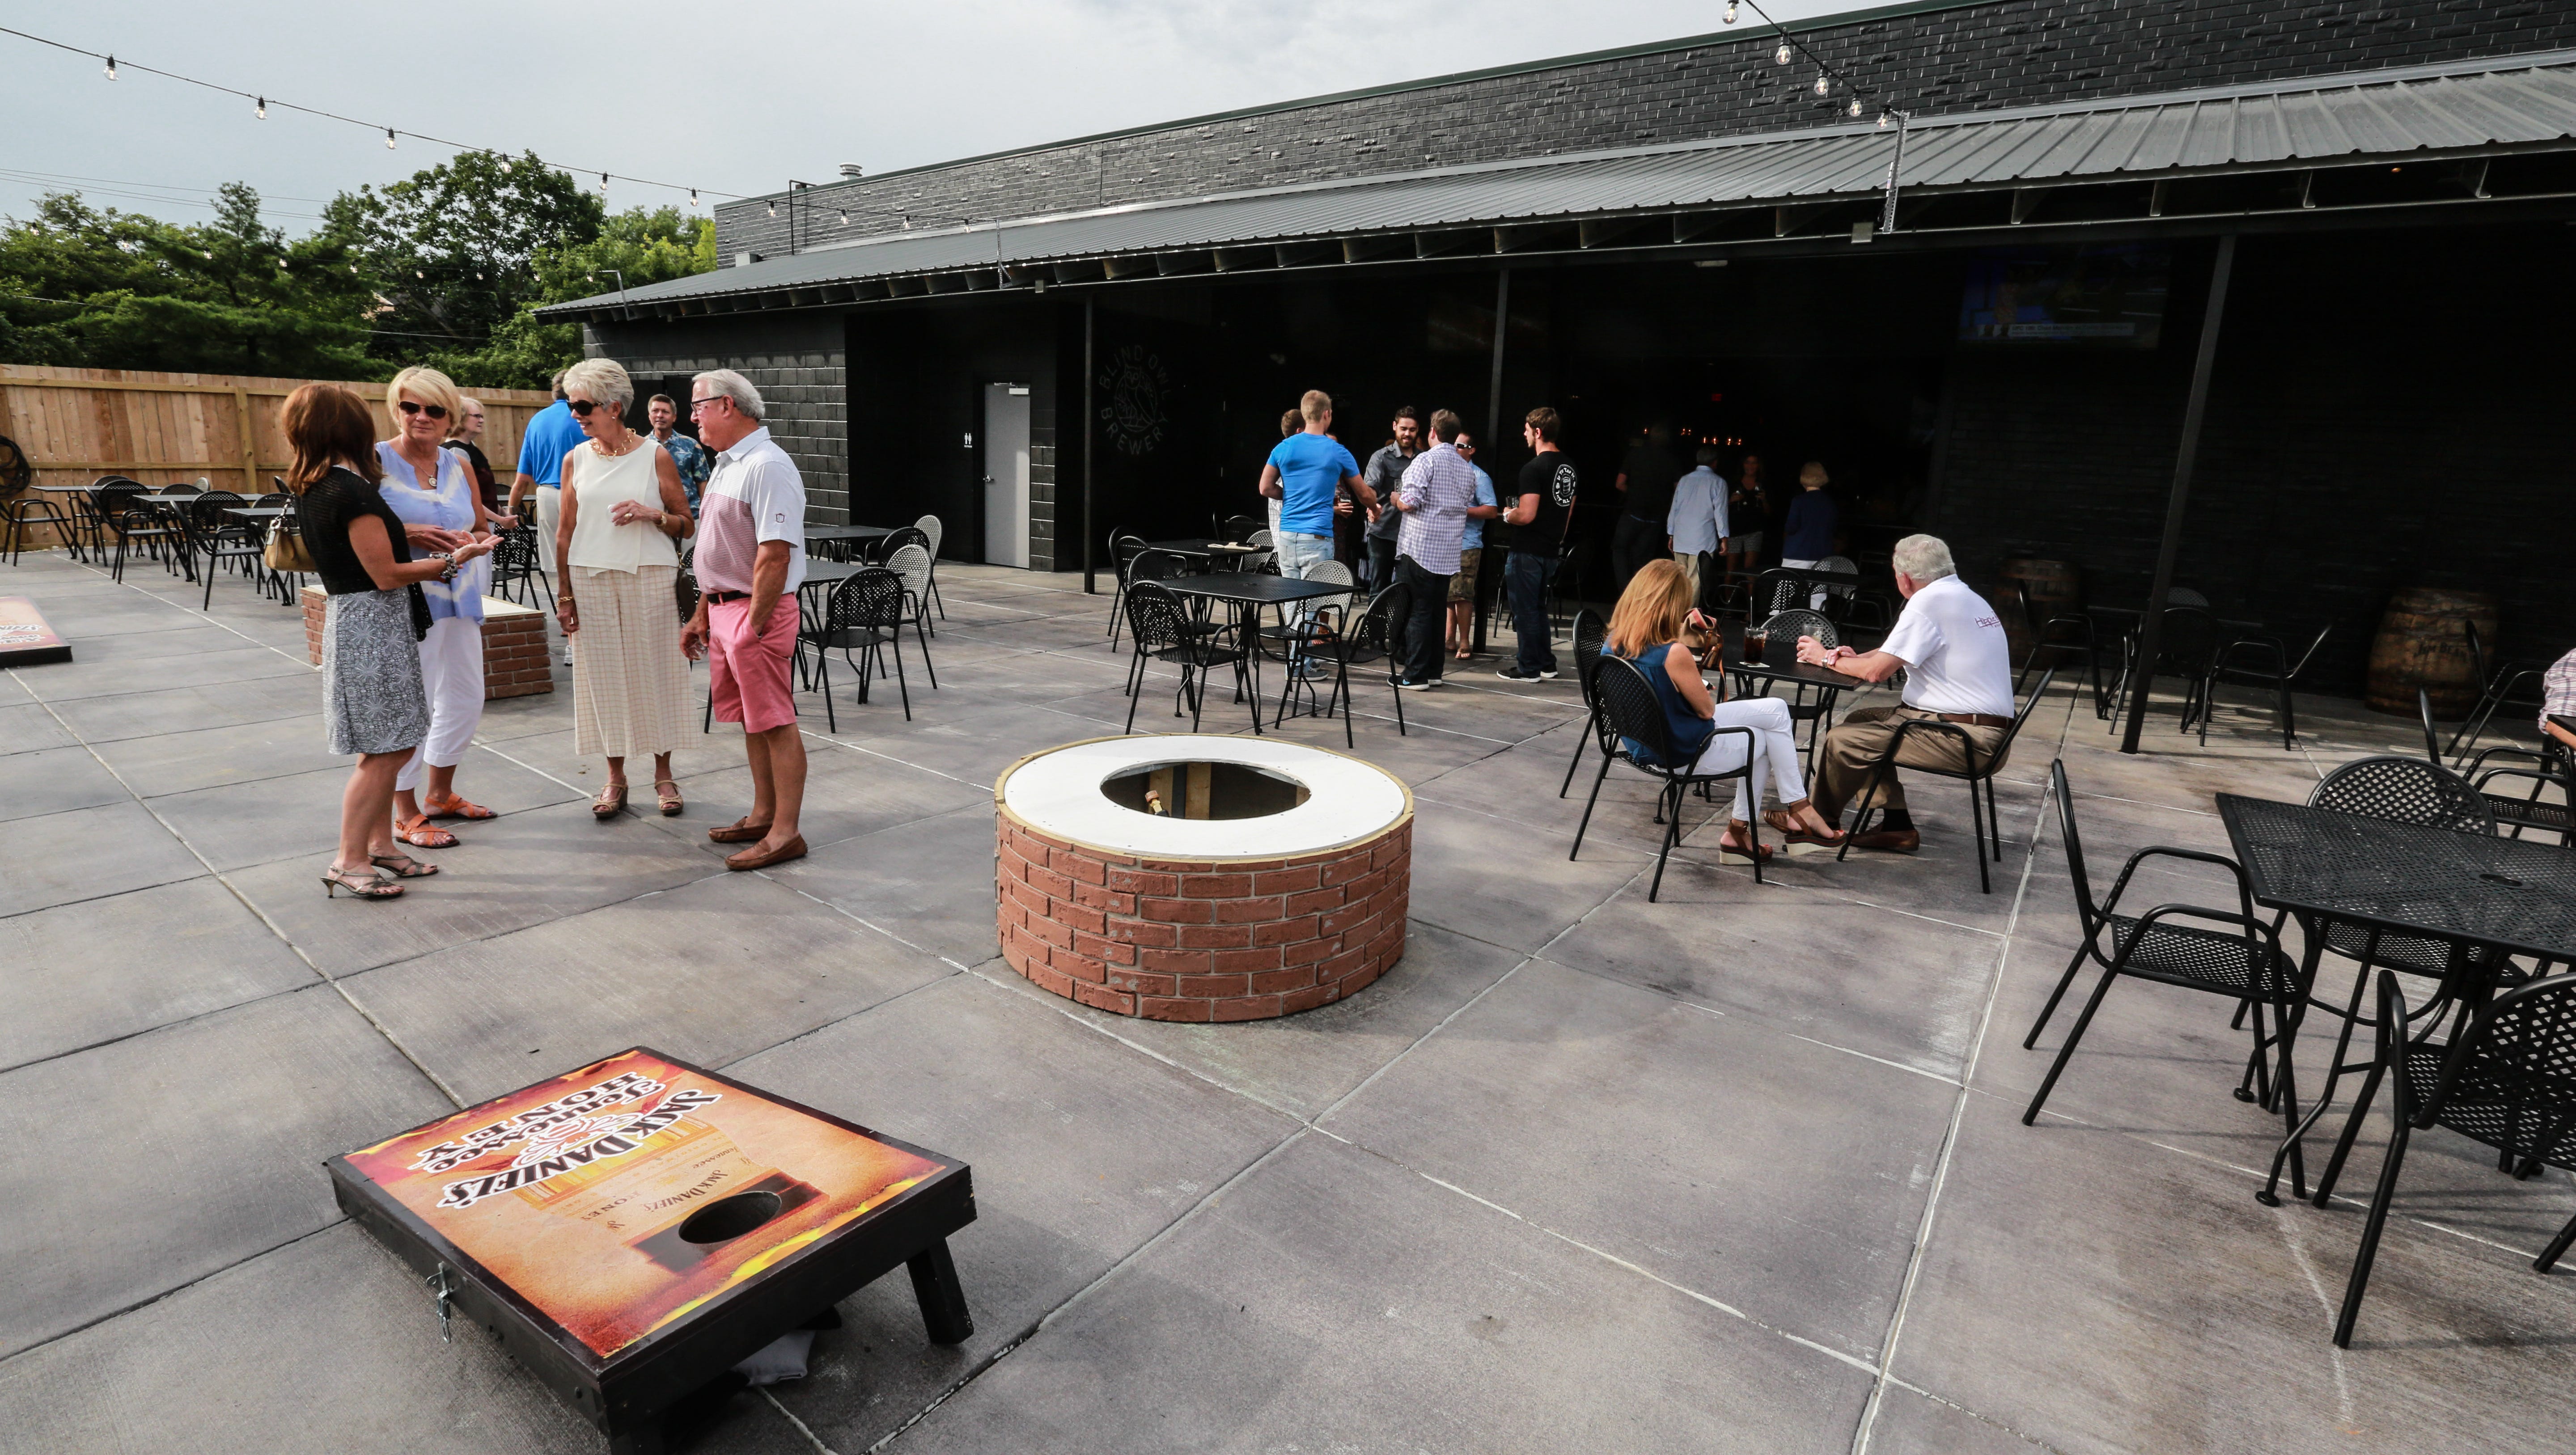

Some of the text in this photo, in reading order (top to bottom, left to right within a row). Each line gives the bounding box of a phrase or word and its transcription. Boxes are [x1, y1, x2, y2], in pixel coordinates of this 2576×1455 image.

[1099, 345, 1171, 400] BLIND OWL
[1101, 407, 1169, 455] BREWERY
[420, 1073, 641, 1162] HONEY
[431, 1080, 664, 1170] Tennessee
[621, 1090, 718, 1138] JACK
[441, 1134, 640, 1208] DANIEL'S
[696, 1170, 729, 1188] JACK
